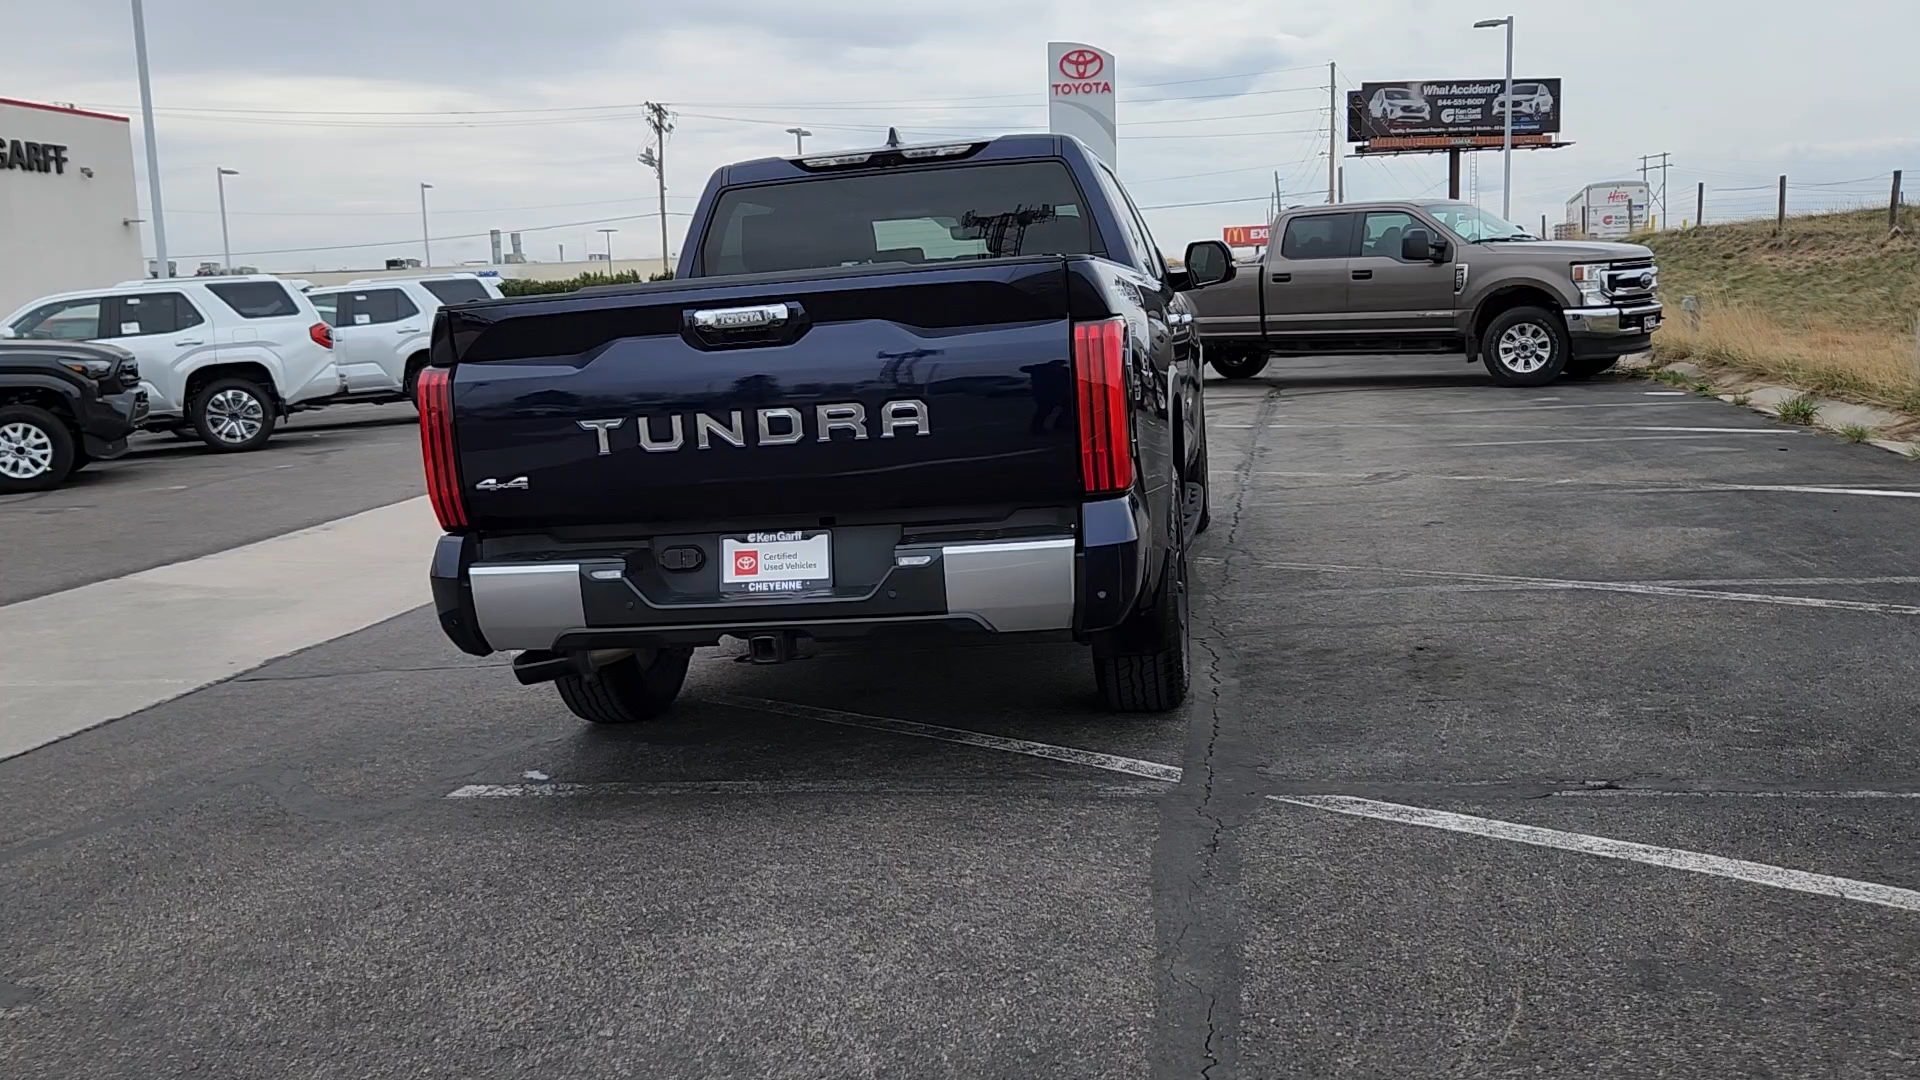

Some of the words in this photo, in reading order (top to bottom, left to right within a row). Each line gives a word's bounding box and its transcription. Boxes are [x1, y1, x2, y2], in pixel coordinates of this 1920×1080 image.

[1052, 82, 1112, 96] TOYOTA
[1423, 85, 1450, 96] What
[1450, 83, 1501, 95] Accident?
[719, 311, 763, 325] TOYOTA
[576, 398, 931, 455] TUNDRA
[757, 533, 777, 542] Ken
[777, 531, 802, 541] Garff
[763, 552, 798, 560] Certified
[785, 561, 817, 570] Vehicles
[748, 581, 803, 592] CHEYENNE
